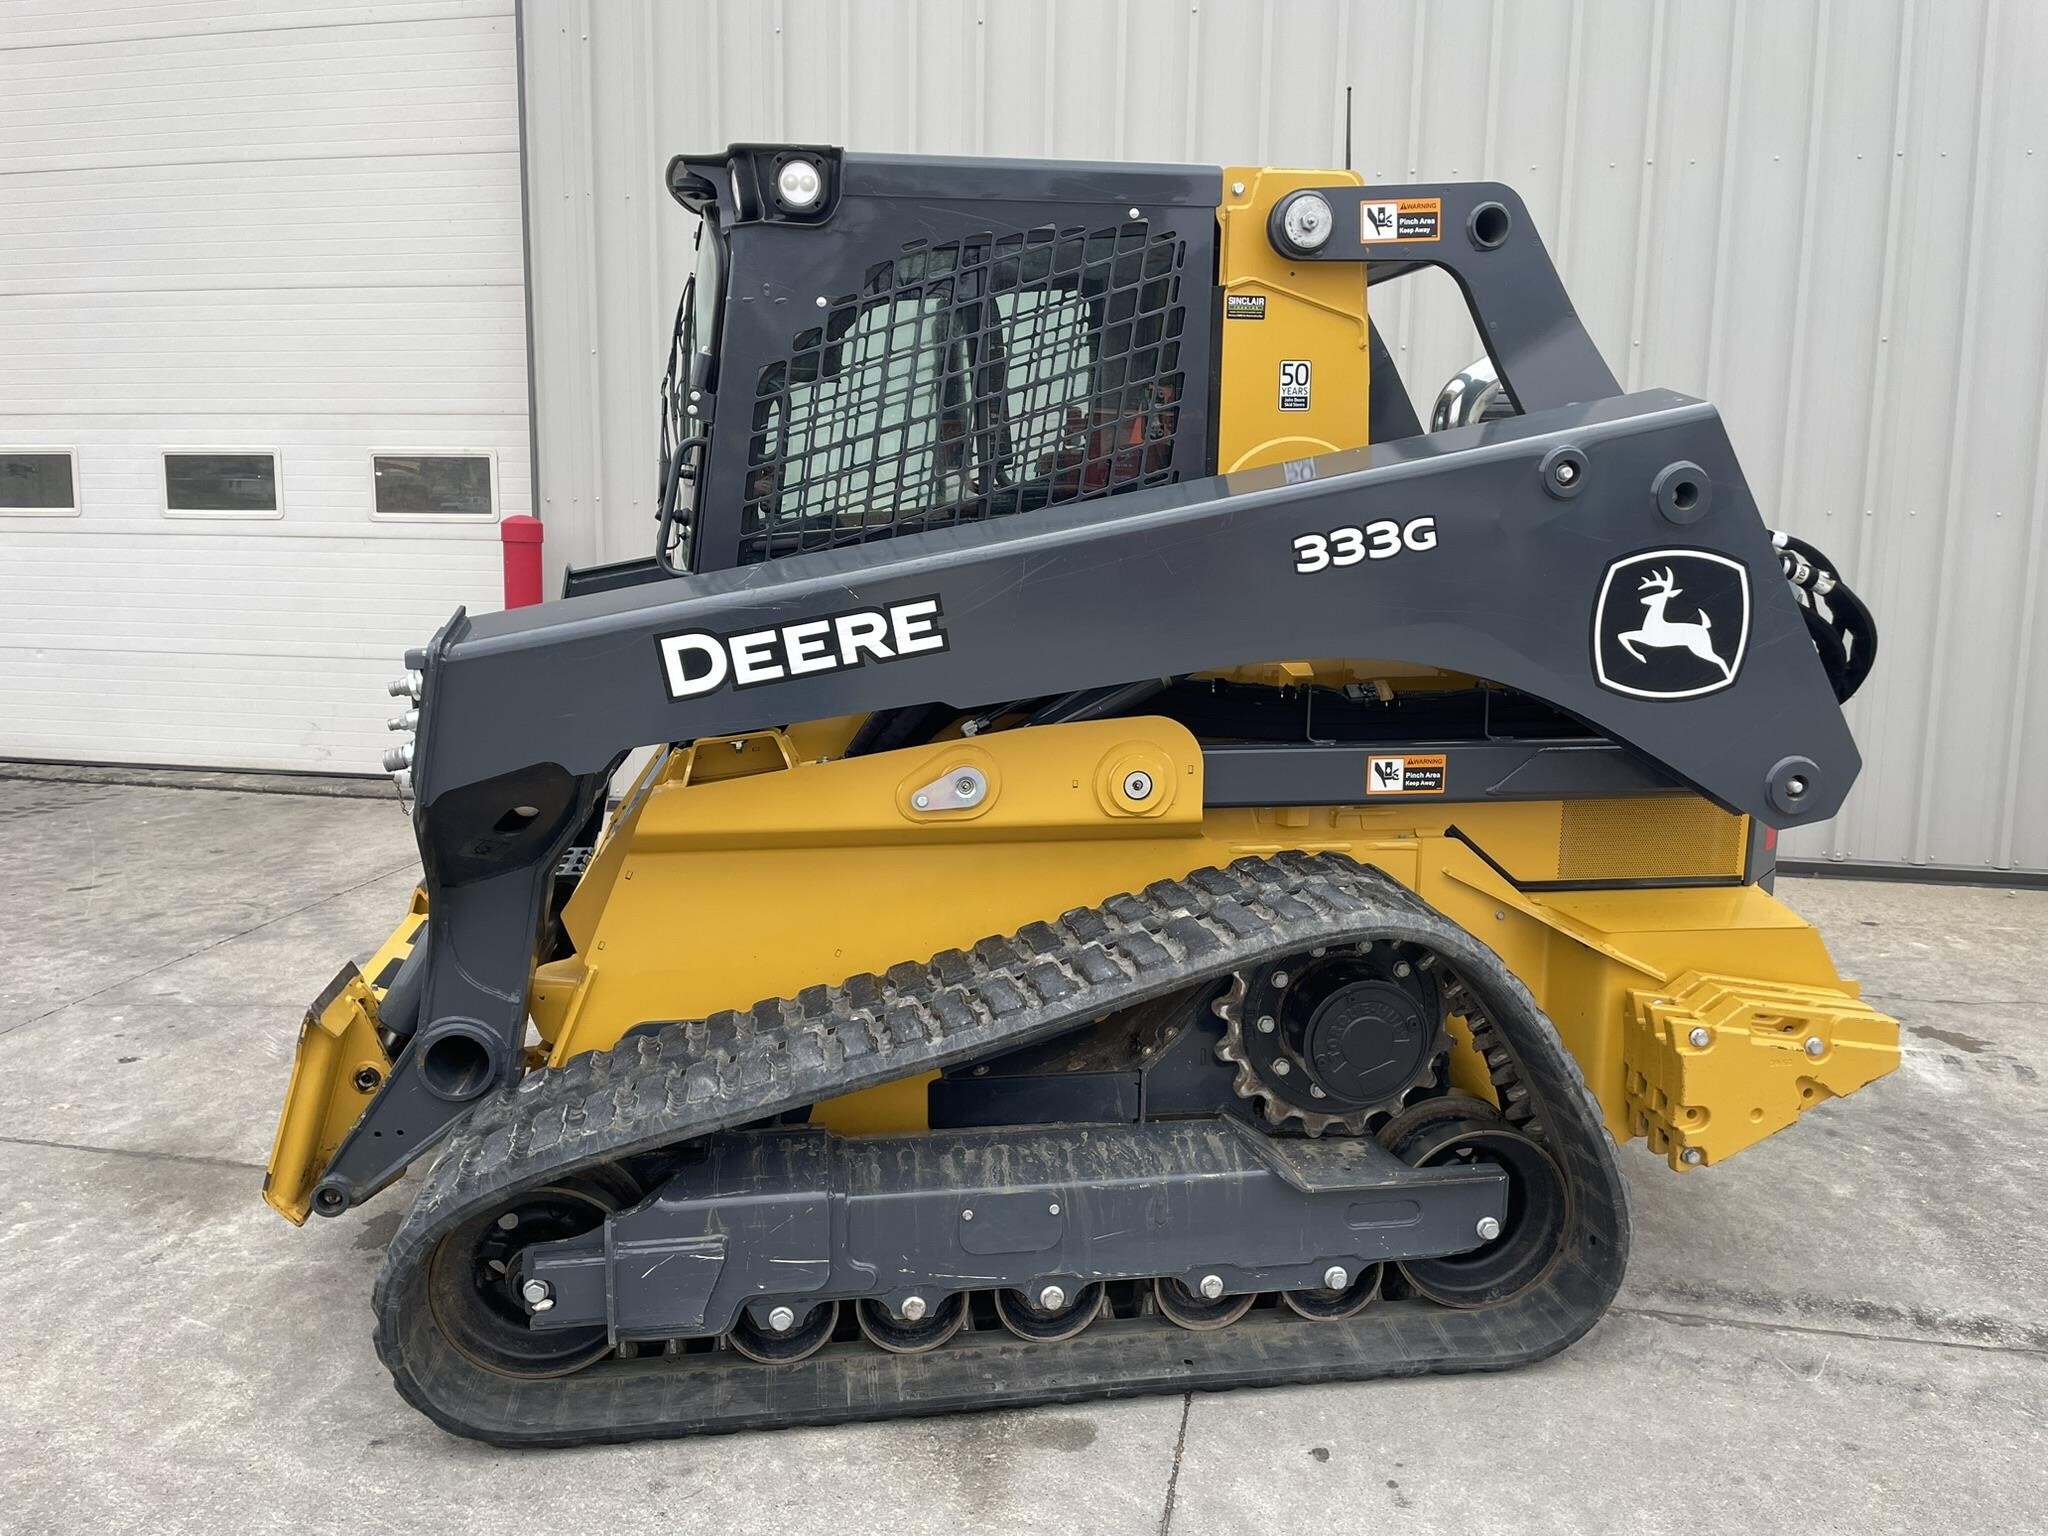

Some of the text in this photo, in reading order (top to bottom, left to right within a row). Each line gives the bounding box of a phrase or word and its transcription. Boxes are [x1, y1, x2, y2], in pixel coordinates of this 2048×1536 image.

[1406, 202, 1437, 210] WARNING
[1228, 296, 1265, 306] SINCLAIR
[1281, 363, 1309, 386] 50
[1281, 386, 1308, 395] YEARS
[1294, 517, 1437, 573] 333G
[660, 600, 944, 697] DEERE
